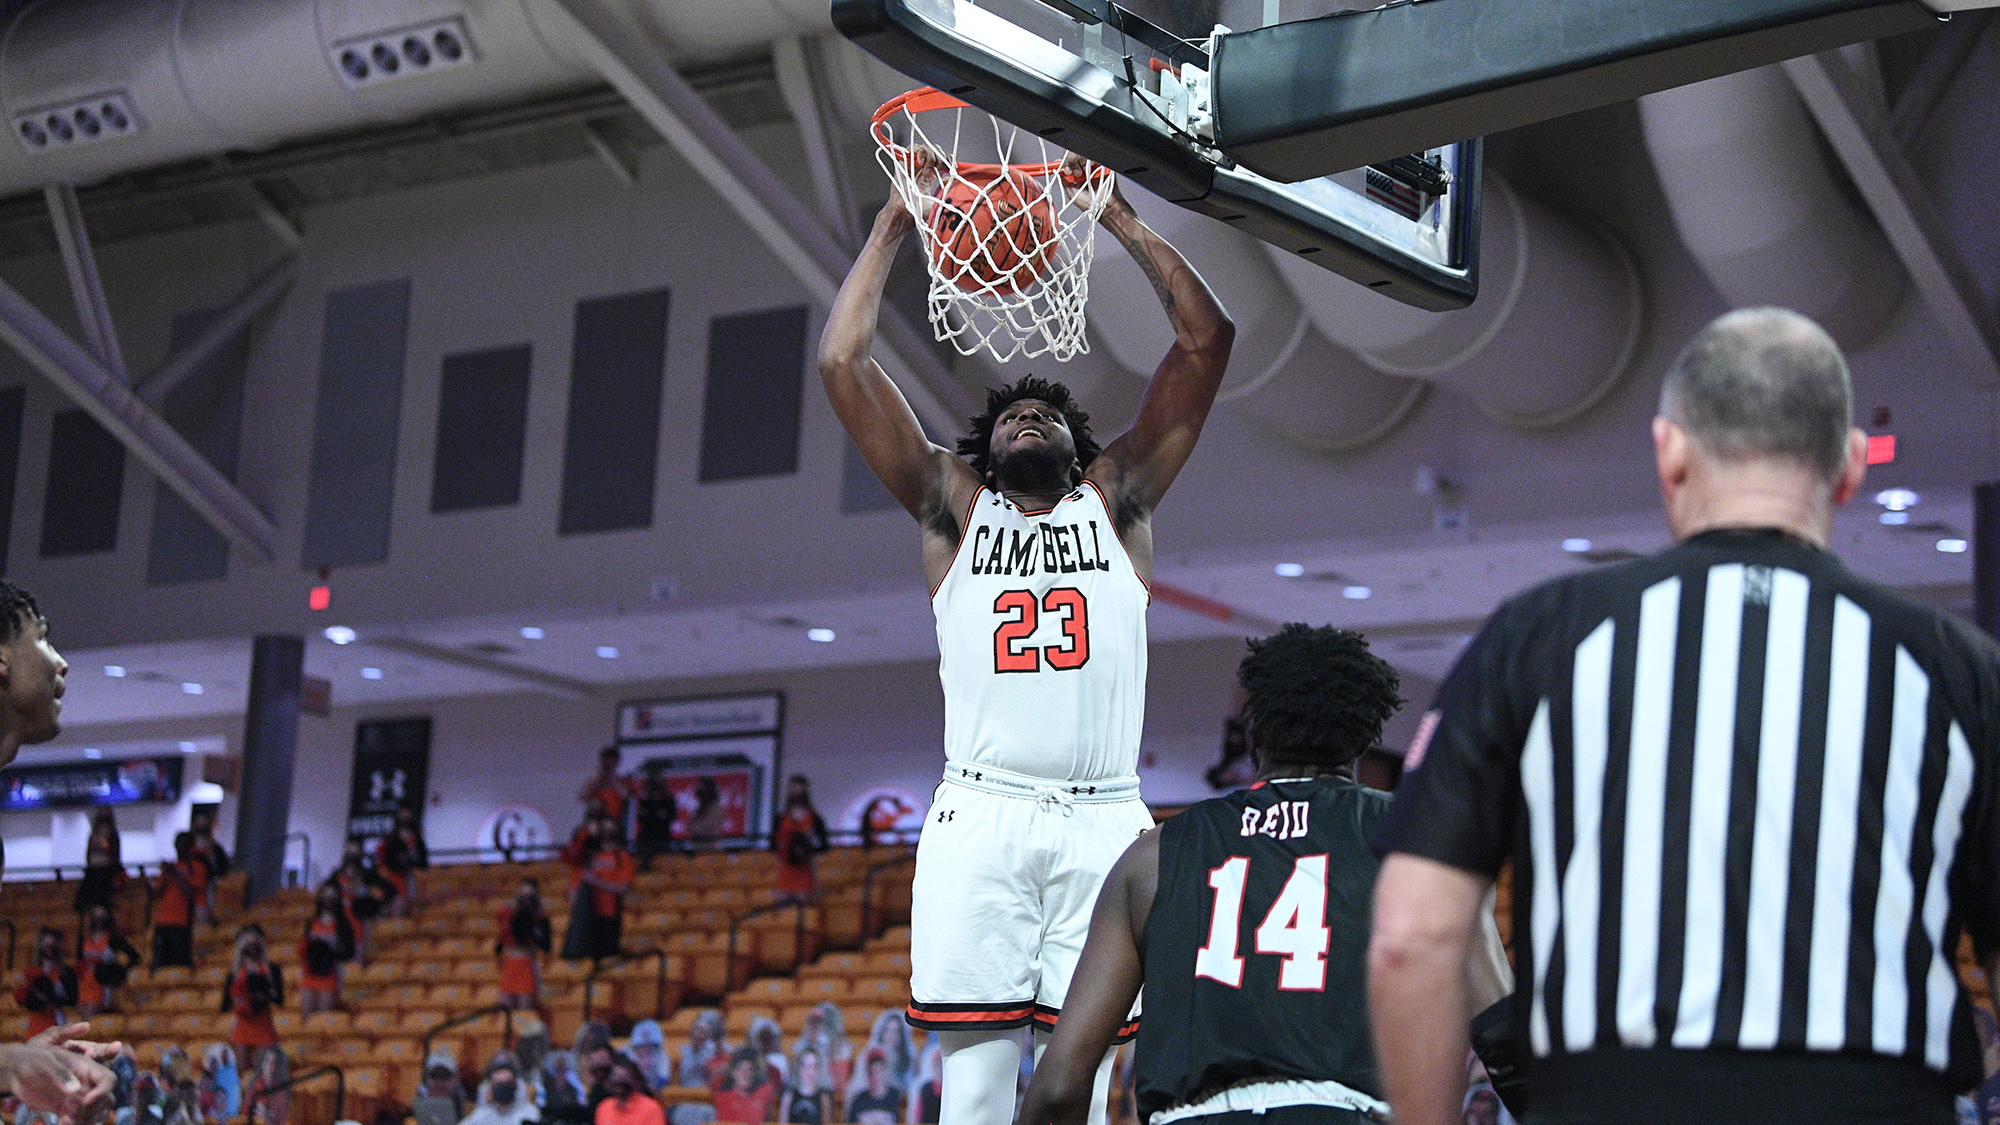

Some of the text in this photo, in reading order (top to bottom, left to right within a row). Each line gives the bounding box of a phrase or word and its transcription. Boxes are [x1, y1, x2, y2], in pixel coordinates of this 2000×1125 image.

[971, 520, 1110, 577] CAMBELL
[993, 587, 1090, 674] 23
[1240, 801, 1309, 840] REID
[1195, 852, 1332, 992] 14
